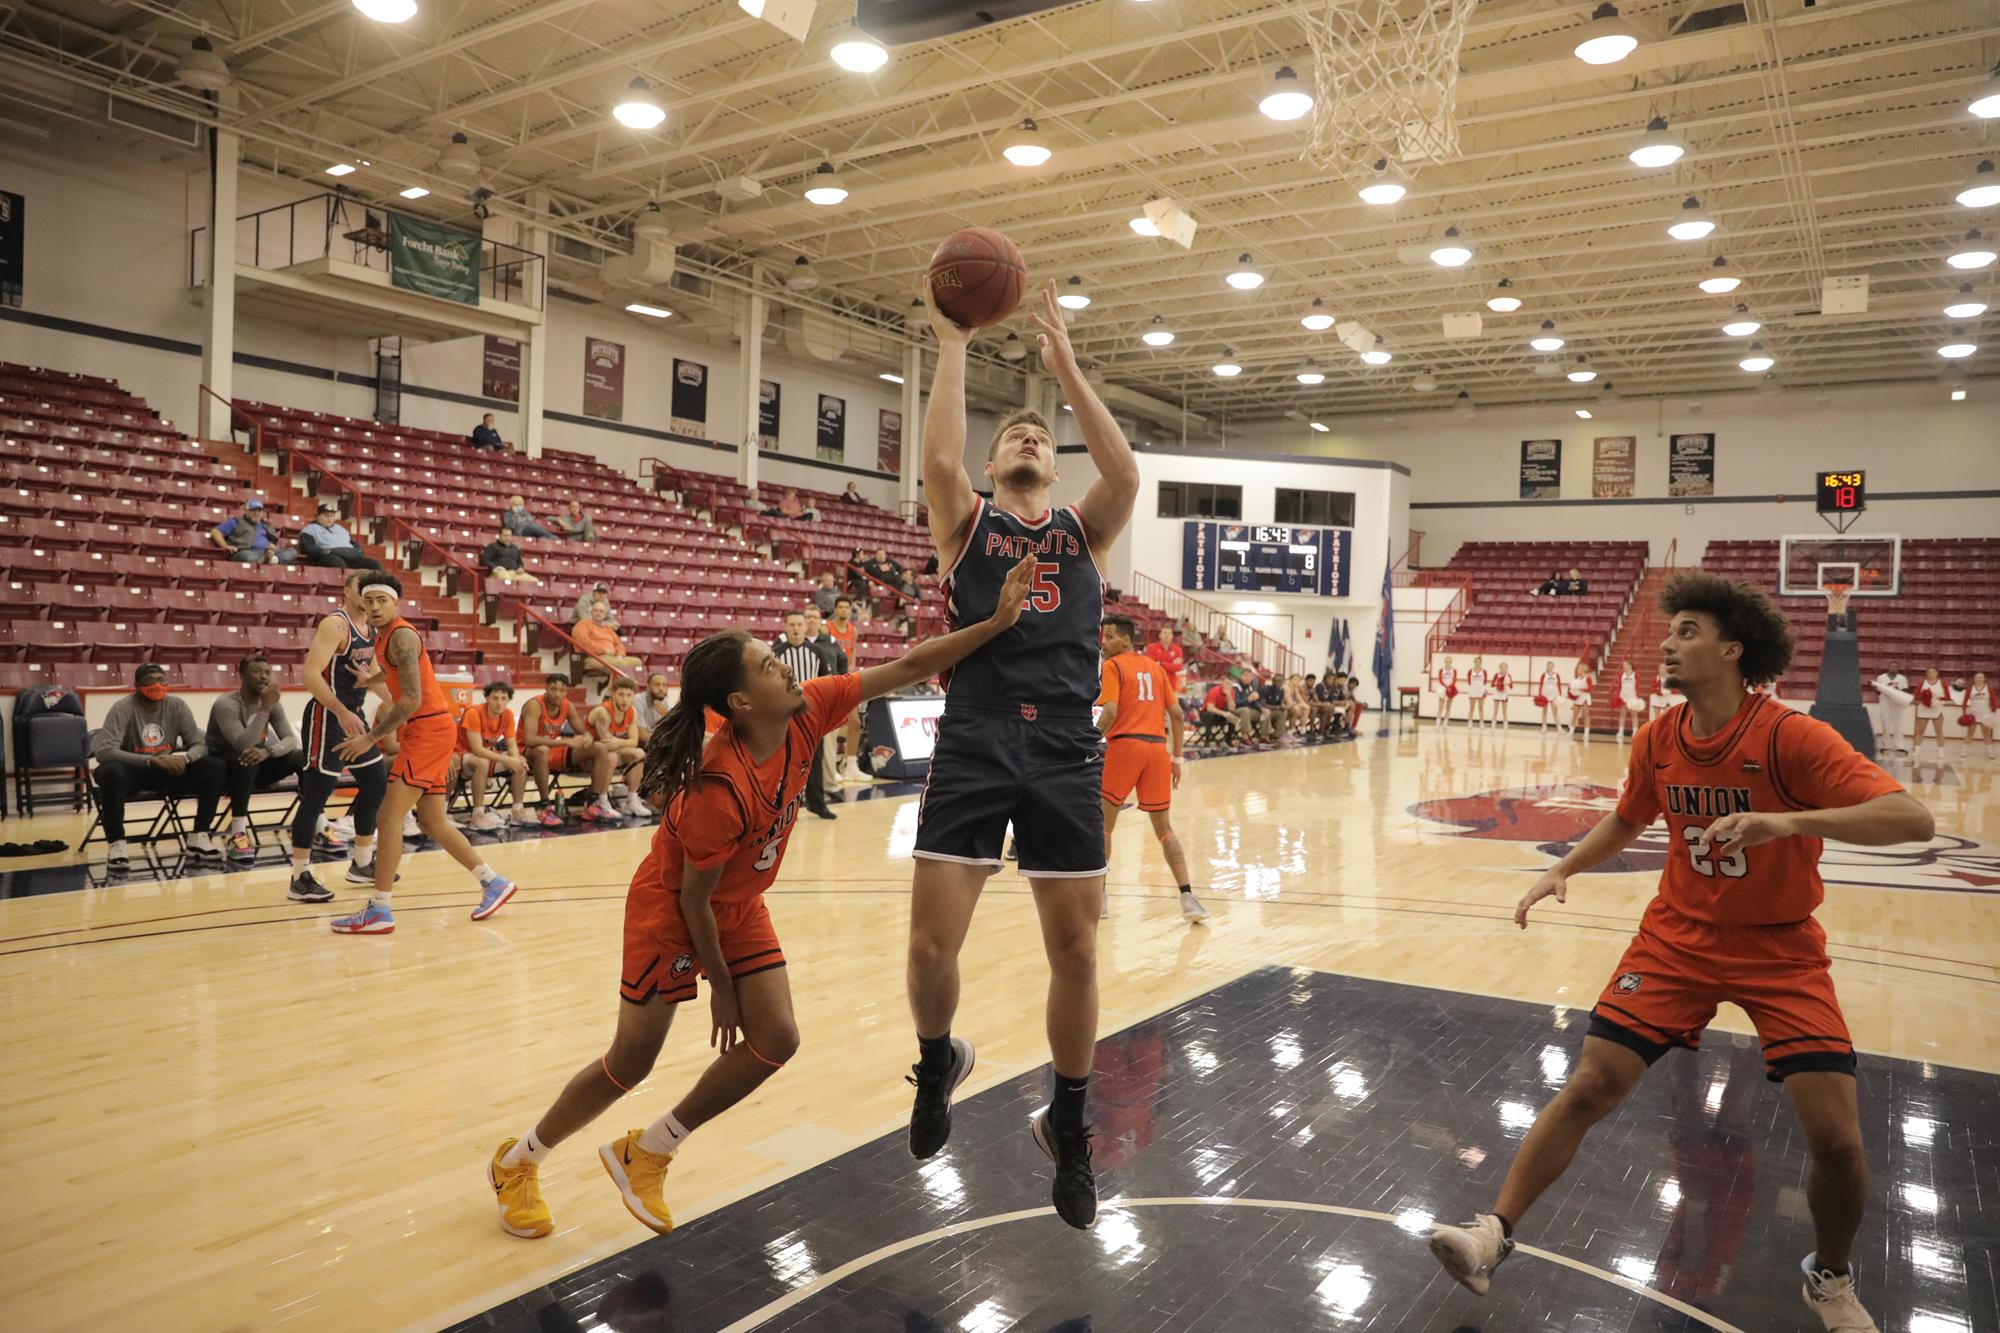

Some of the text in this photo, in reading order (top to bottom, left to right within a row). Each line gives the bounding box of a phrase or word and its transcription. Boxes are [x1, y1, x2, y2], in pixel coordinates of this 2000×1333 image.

[402, 235, 460, 261] Forcht Bank
[1825, 473, 1862, 488] 16:43
[1835, 486, 1856, 508] 18
[1684, 502, 1696, 516] B
[985, 529, 1080, 559] PATROTS
[1256, 526, 1290, 543] 16:43
[1237, 550, 1246, 566] 7
[1304, 554, 1315, 570] 8
[1136, 672, 1155, 702] 11
[1666, 785, 1752, 818] UNION
[1683, 825, 1748, 879] 23
